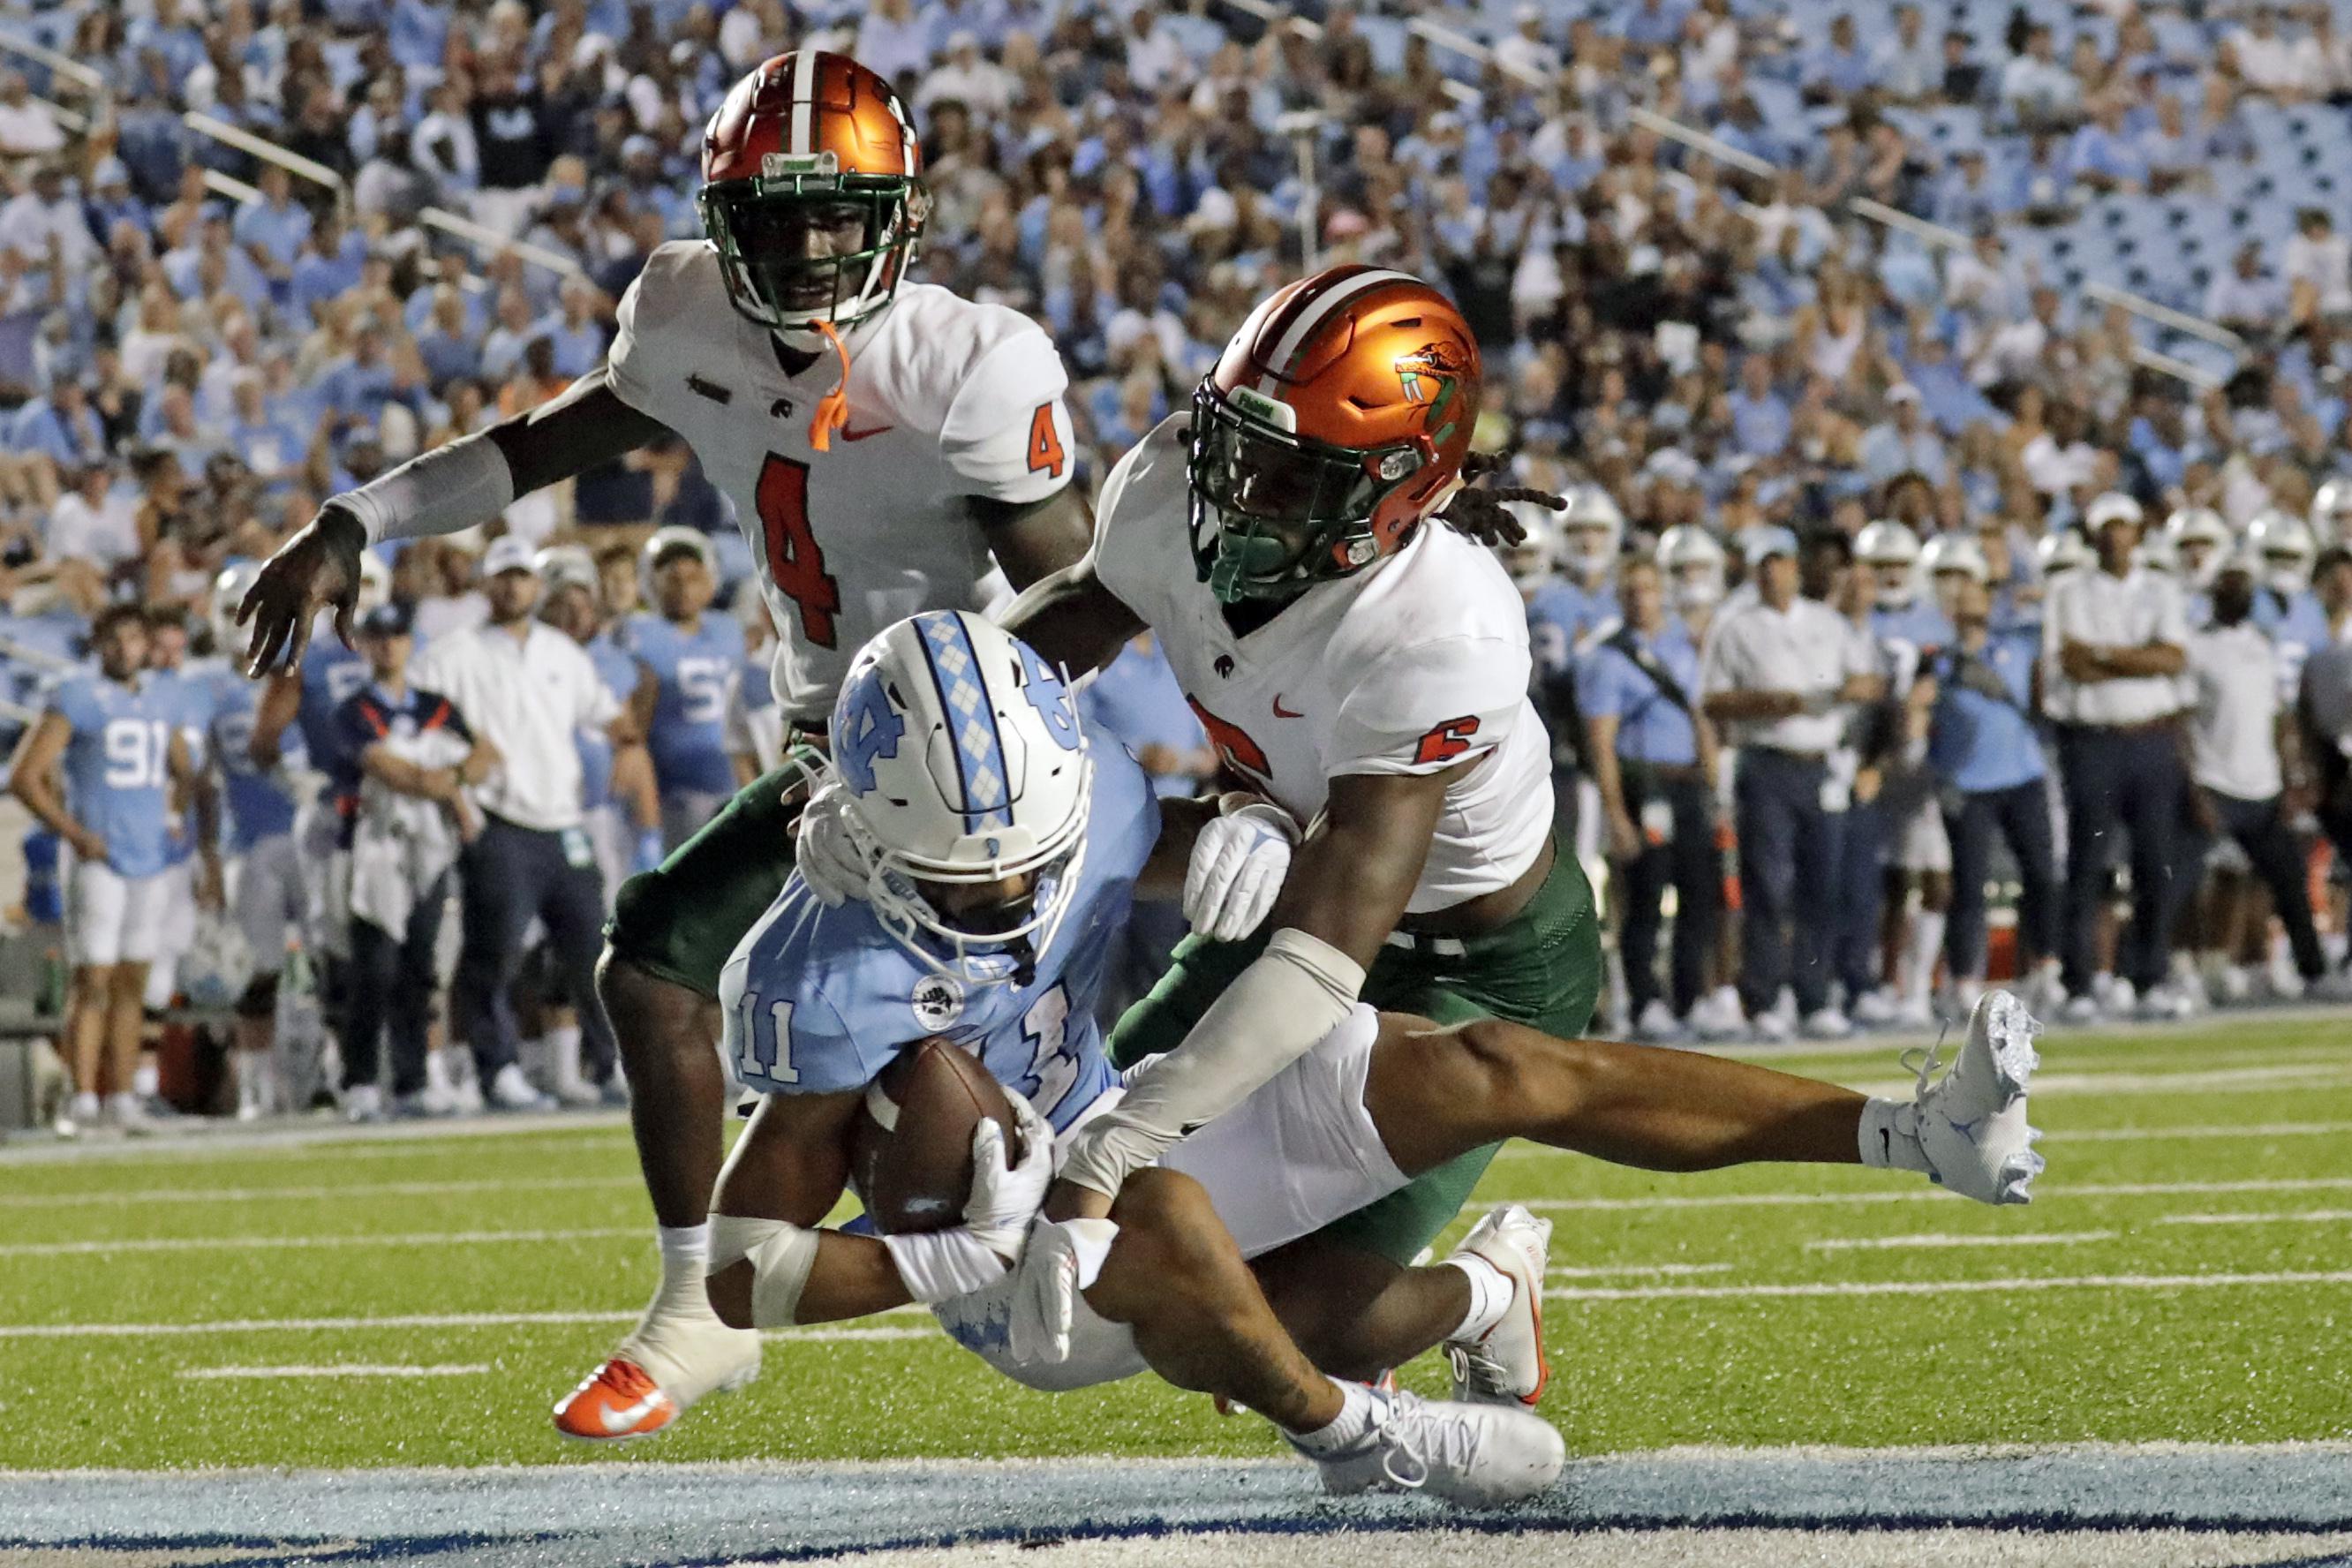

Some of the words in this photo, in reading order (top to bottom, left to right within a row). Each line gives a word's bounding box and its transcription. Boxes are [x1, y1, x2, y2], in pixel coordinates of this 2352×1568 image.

[1028, 402, 1065, 479] 4
[755, 451, 841, 651] 4
[106, 718, 168, 788] 91
[740, 991, 800, 1083] 11
